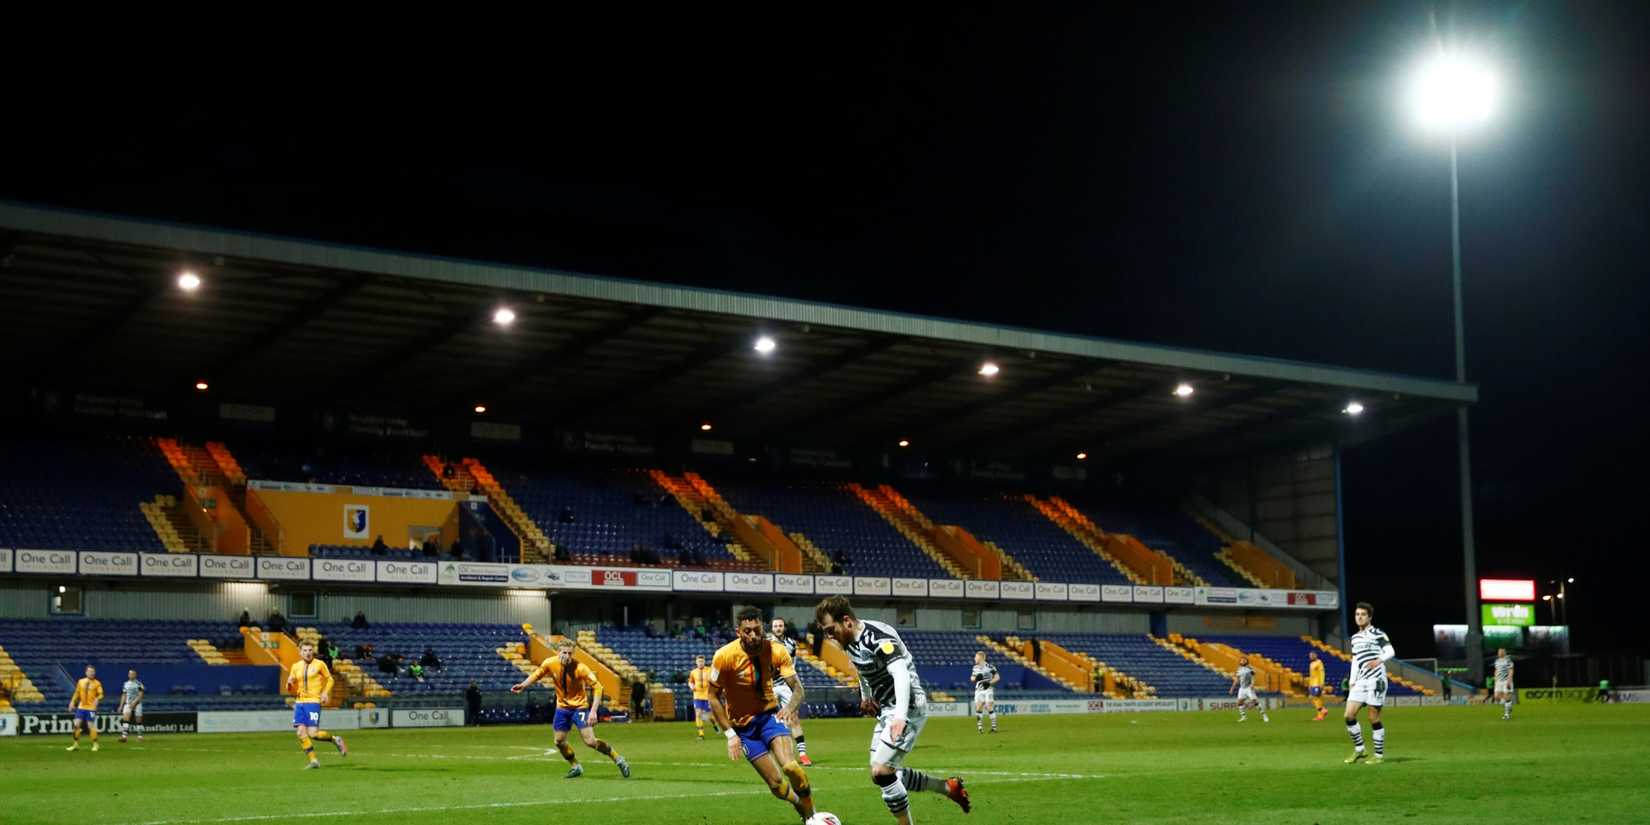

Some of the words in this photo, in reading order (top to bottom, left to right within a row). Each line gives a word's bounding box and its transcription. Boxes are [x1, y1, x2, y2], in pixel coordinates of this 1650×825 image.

[21, 553, 46, 564] One
[50, 553, 71, 565] Call
[84, 555, 108, 566] One
[111, 555, 132, 567] Call
[145, 556, 169, 567] One
[172, 556, 192, 568] Call
[204, 558, 226, 569] One
[229, 559, 249, 570] Call
[262, 560, 284, 571] One
[286, 560, 305, 572] Call
[322, 562, 344, 572] One
[347, 562, 366, 573] Call
[386, 563, 408, 574] One
[410, 564, 429, 576] Call
[604, 571, 624, 580] OCL
[681, 573, 698, 583] One
[701, 574, 716, 584] Call
[732, 575, 749, 584] One
[752, 575, 766, 585] Call
[778, 576, 794, 586] One
[796, 577, 810, 587] Call
[818, 578, 834, 587] One
[835, 578, 849, 588] Call
[857, 579, 873, 588] One
[874, 579, 888, 589] Call
[895, 580, 910, 589] One
[912, 580, 925, 590] Call
[928, 703, 946, 713] One
[309, 711, 319, 721] 10
[409, 711, 430, 721] One
[431, 710, 449, 721] Call
[578, 711, 586, 722] 7
[23, 715, 82, 734] Prin
[94, 714, 123, 733] UK
[128, 723, 177, 733] (Mnsfield)
[180, 723, 194, 732] Ltd
